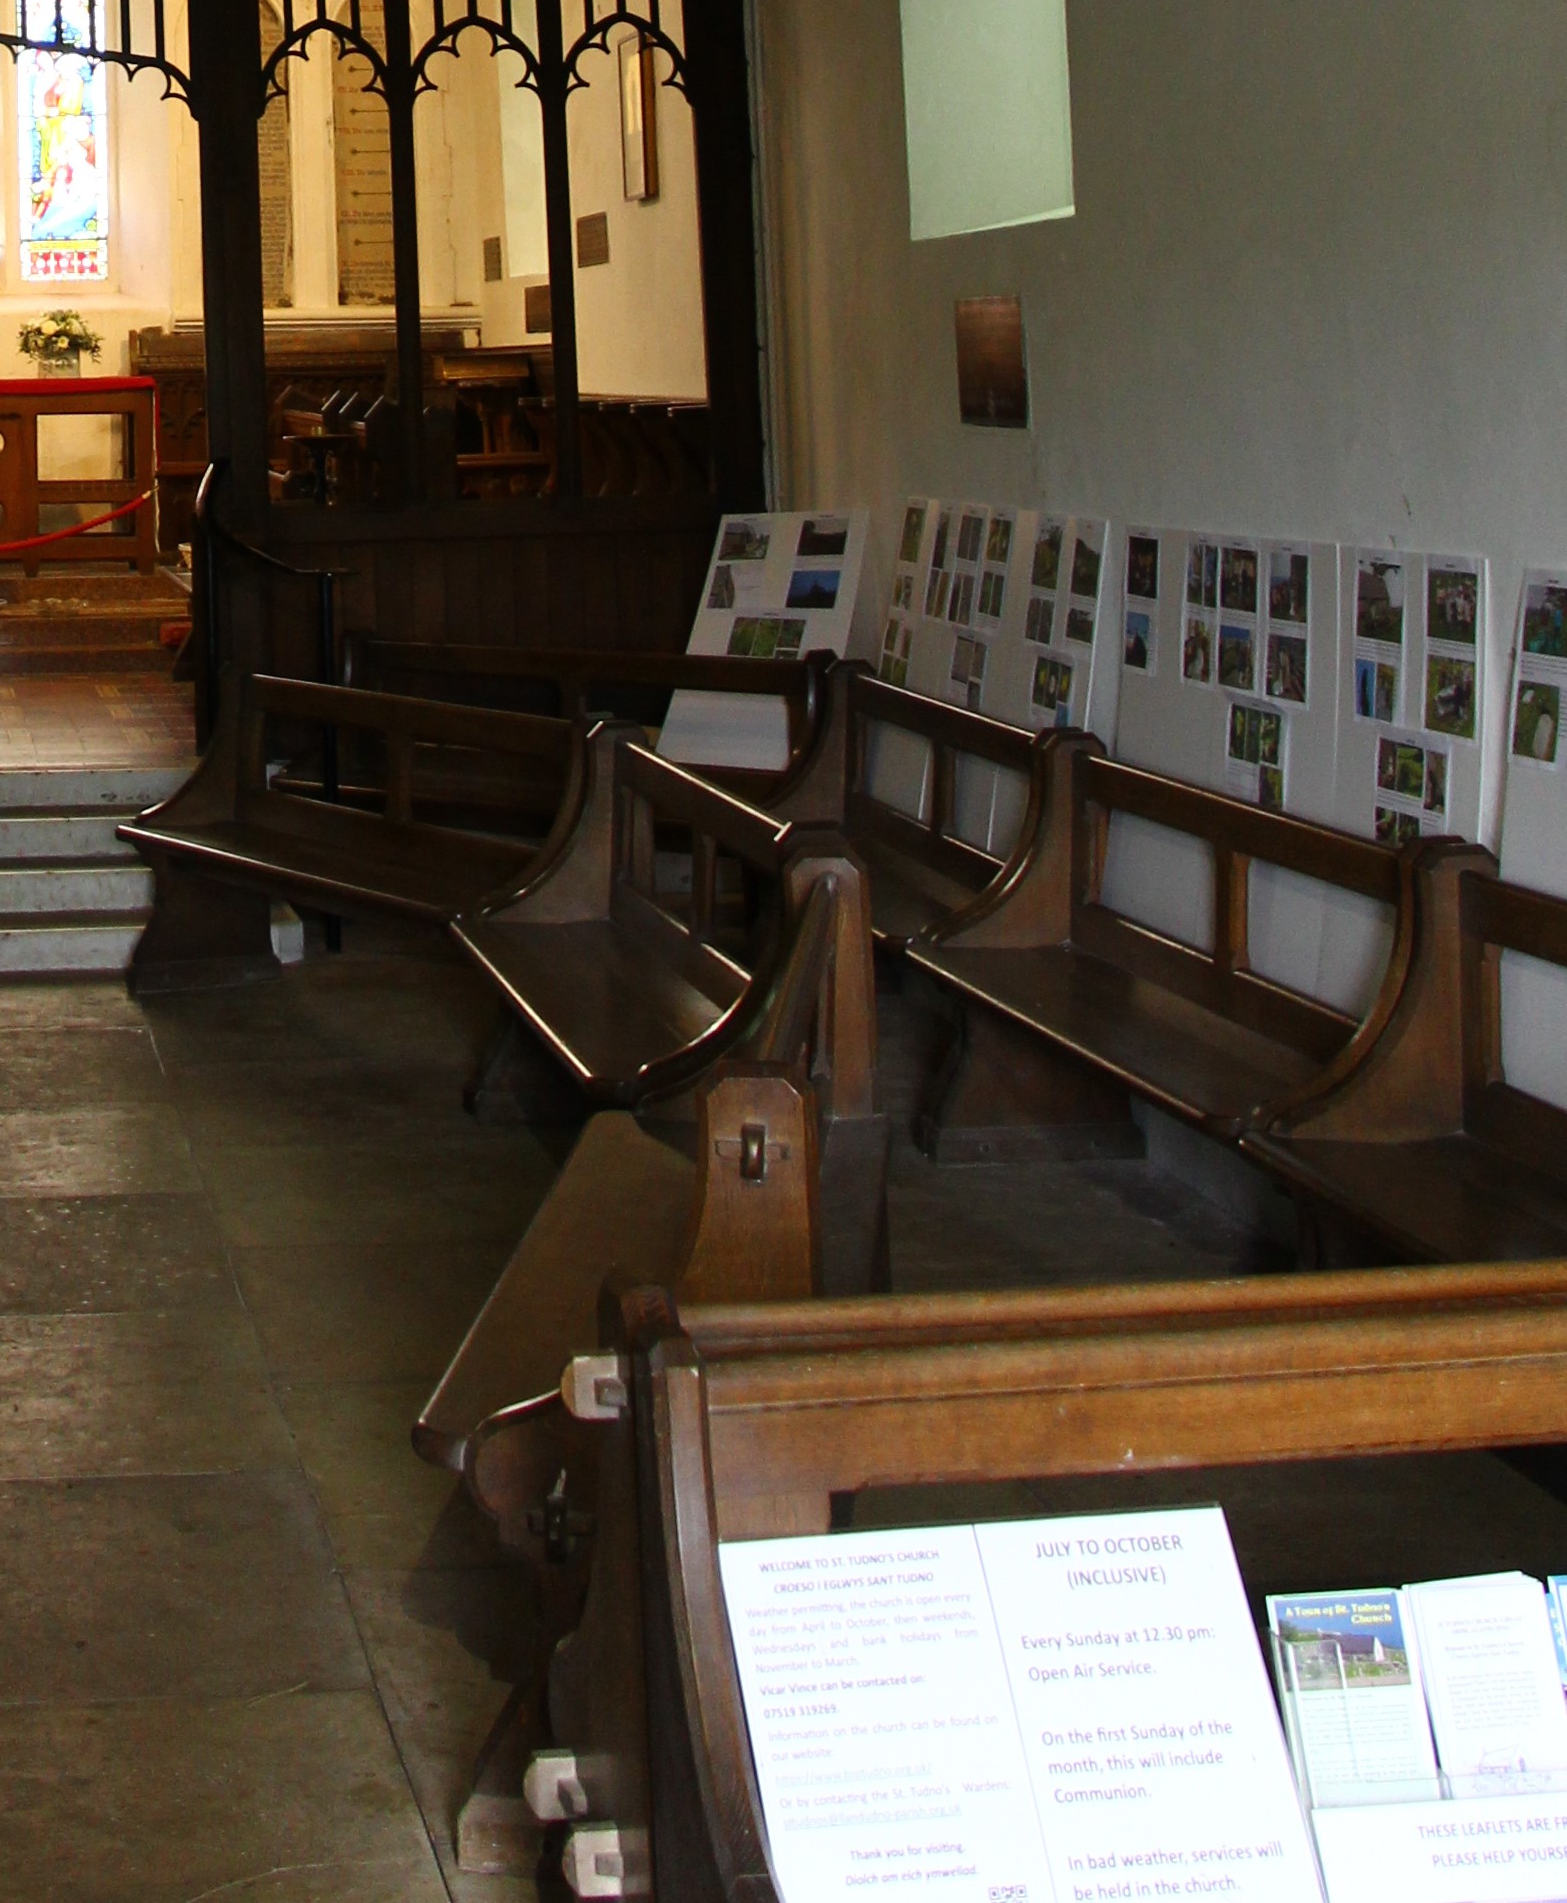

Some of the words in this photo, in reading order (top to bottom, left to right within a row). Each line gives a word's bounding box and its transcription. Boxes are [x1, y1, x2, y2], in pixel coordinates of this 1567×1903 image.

[1036, 1541, 1071, 1558] JULY
[1076, 1539, 1099, 1555] TO
[1104, 1534, 1183, 1554] OCTOBER
[758, 1560, 811, 1572] WELCOME
[816, 1558, 829, 1568] TO
[831, 1557, 845, 1567] ST.
[848, 1553, 894, 1566] TUDNO'S
[897, 1549, 940, 1562] CHURCH
[774, 1582, 814, 1594] CROESO
[824, 1577, 864, 1591] EGLWYS
[867, 1574, 893, 1587] SANT
[896, 1572, 934, 1585] TUDNO
[1066, 1565, 1167, 1591] (INCLUSIVE)
[745, 1606, 788, 1619] Weather
[849, 1600, 866, 1610] the
[868, 1597, 903, 1609] church
[905, 1595, 913, 1605] is
[916, 1594, 941, 1607] open
[943, 1592, 971, 1603] every
[748, 1626, 767, 1638] day
[771, 1623, 797, 1635] from
[802, 1620, 825, 1633] April
[830, 1620, 842, 1630] to
[893, 1614, 917, 1626] then
[752, 1641, 816, 1655] Wednesdays
[830, 1638, 849, 1649] and
[862, 1634, 887, 1646] bank
[899, 1630, 941, 1643] holidays
[954, 1627, 979, 1639] from
[1021, 1634, 1062, 1651] Every
[1066, 1631, 1120, 1647] Sunday
[1124, 1629, 1138, 1643] at
[1143, 1625, 1182, 1642] 12.30
[1187, 1627, 1216, 1642] pm:
[755, 1660, 808, 1674] November
[811, 1659, 823, 1669] to
[1028, 1666, 1069, 1684] Open
[1073, 1663, 1094, 1678] Air
[1098, 1660, 1157, 1677] Service.
[759, 1684, 786, 1696] Vicar
[788, 1682, 818, 1694] Vince
[820, 1681, 838, 1691] can
[841, 1679, 854, 1690] be
[856, 1675, 907, 1689] contacted
[763, 1706, 796, 1719] 07519
[767, 1729, 829, 1742] Information
[832, 1727, 847, 1737] on
[850, 1725, 869, 1736] the
[872, 1721, 907, 1734] church
[911, 1720, 929, 1730] can
[932, 1717, 946, 1728] be
[950, 1714, 980, 1726] found
[984, 1715, 998, 1724] on
[1041, 1731, 1064, 1746] On
[1067, 1729, 1093, 1744] the
[1096, 1726, 1128, 1742] first
[1130, 1724, 1185, 1741] Sunday
[1189, 1721, 1204, 1737] of
[1208, 1719, 1232, 1735] the
[771, 1752, 788, 1762] our
[1048, 1758, 1104, 1775] month,
[1106, 1755, 1135, 1771] this
[1138, 1752, 1166, 1769] will
[1169, 1749, 1224, 1767] include
[779, 1798, 792, 1809] Or
[796, 1796, 810, 1808] by
[813, 1791, 868, 1806] contacting
[871, 1789, 888, 1800] the
[1053, 1785, 1153, 1804] Communion.
[1417, 1823, 1458, 1839] THESE
[1461, 1819, 1522, 1836] LEAFLETS
[1525, 1817, 1551, 1831] ARE
[850, 1849, 882, 1861] Thank
[884, 1848, 904, 1859] you
[907, 1845, 922, 1855] for
[1067, 1856, 1083, 1872] In
[1088, 1853, 1116, 1870] bad
[1121, 1849, 1188, 1866] weather,
[1191, 1845, 1252, 1863] services
[1255, 1840, 1283, 1858] will
[1432, 1851, 1480, 1867] PLEASE
[1482, 1850, 1515, 1864] HELP
[845, 1873, 878, 1886] Diolch
[881, 1873, 898, 1882] am
[901, 1869, 922, 1881] eich
[1073, 1885, 1092, 1902] be
[1097, 1883, 1131, 1899] held
[1136, 1881, 1151, 1897] in
[1154, 1880, 1180, 1895] the
[1185, 1874, 1242, 1892] church.
